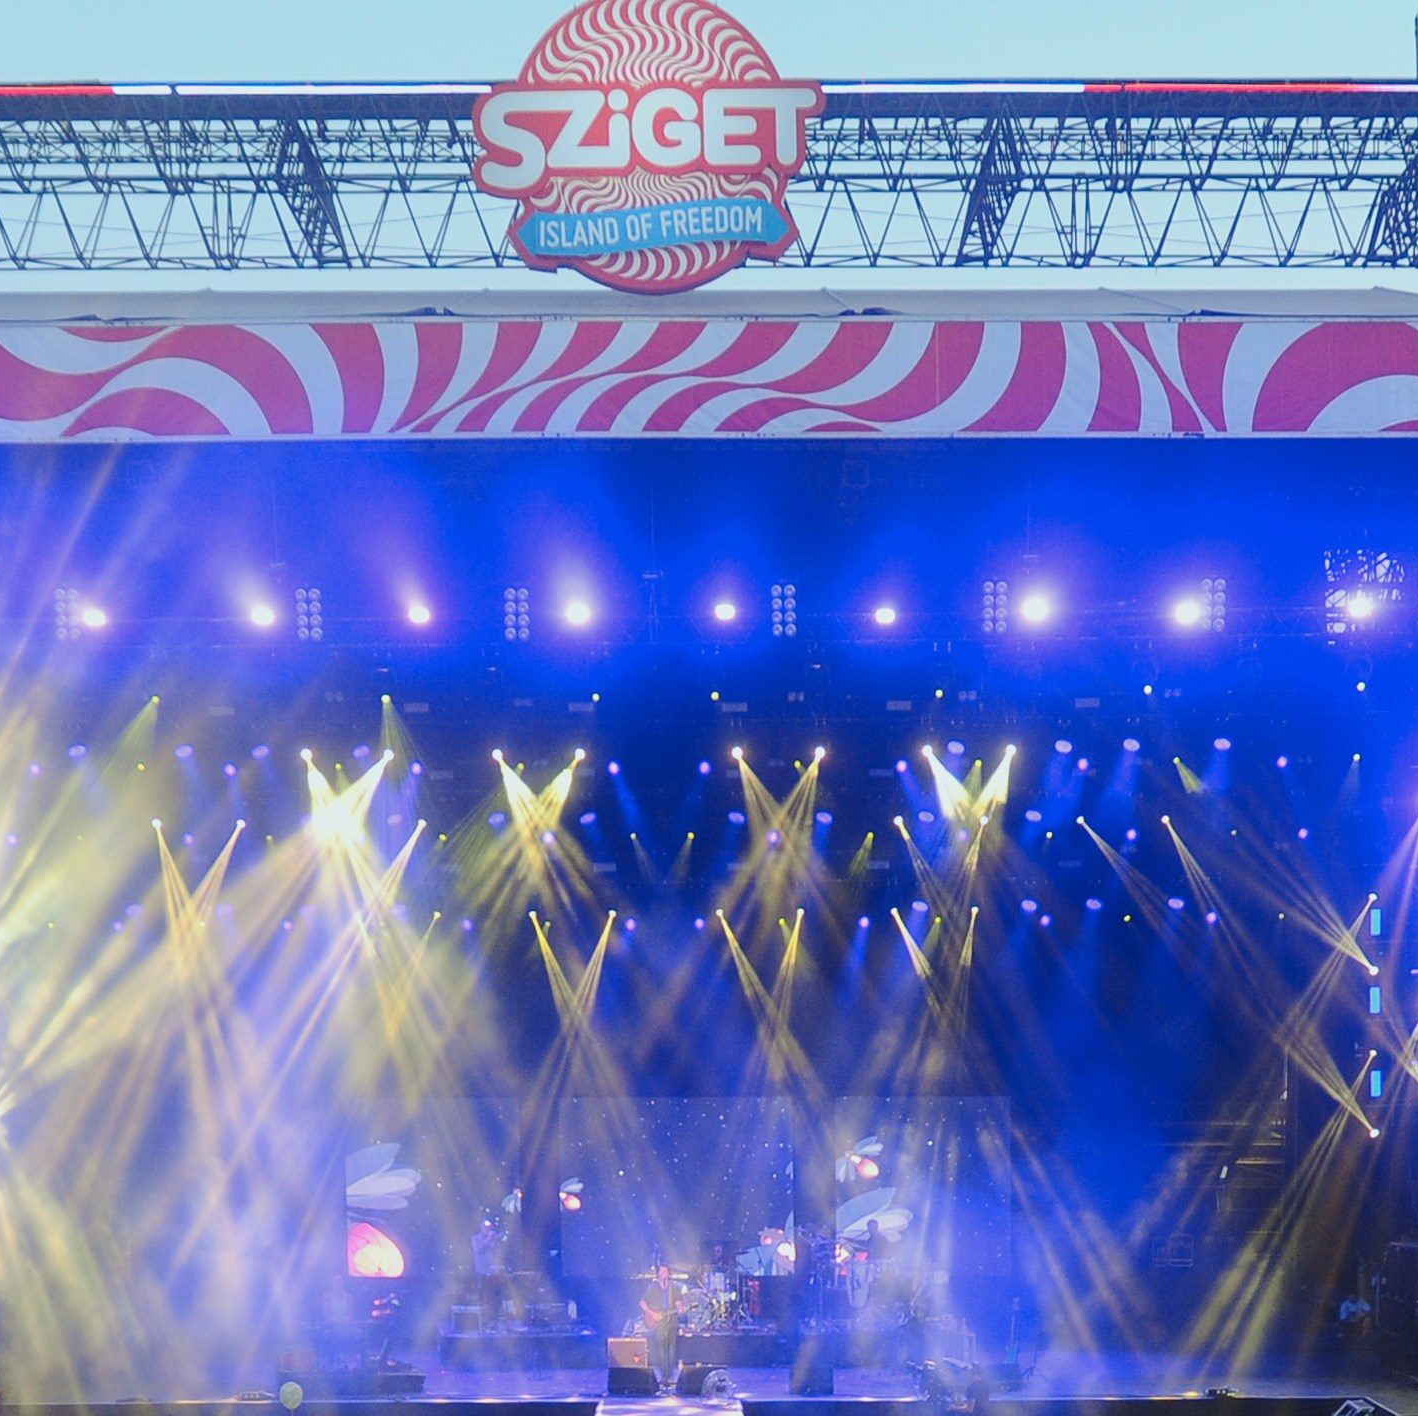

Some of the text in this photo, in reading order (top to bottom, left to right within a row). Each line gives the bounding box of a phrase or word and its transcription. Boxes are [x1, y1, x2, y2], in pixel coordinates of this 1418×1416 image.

[538, 206, 763, 248] ISLAND OF FREEDOM
